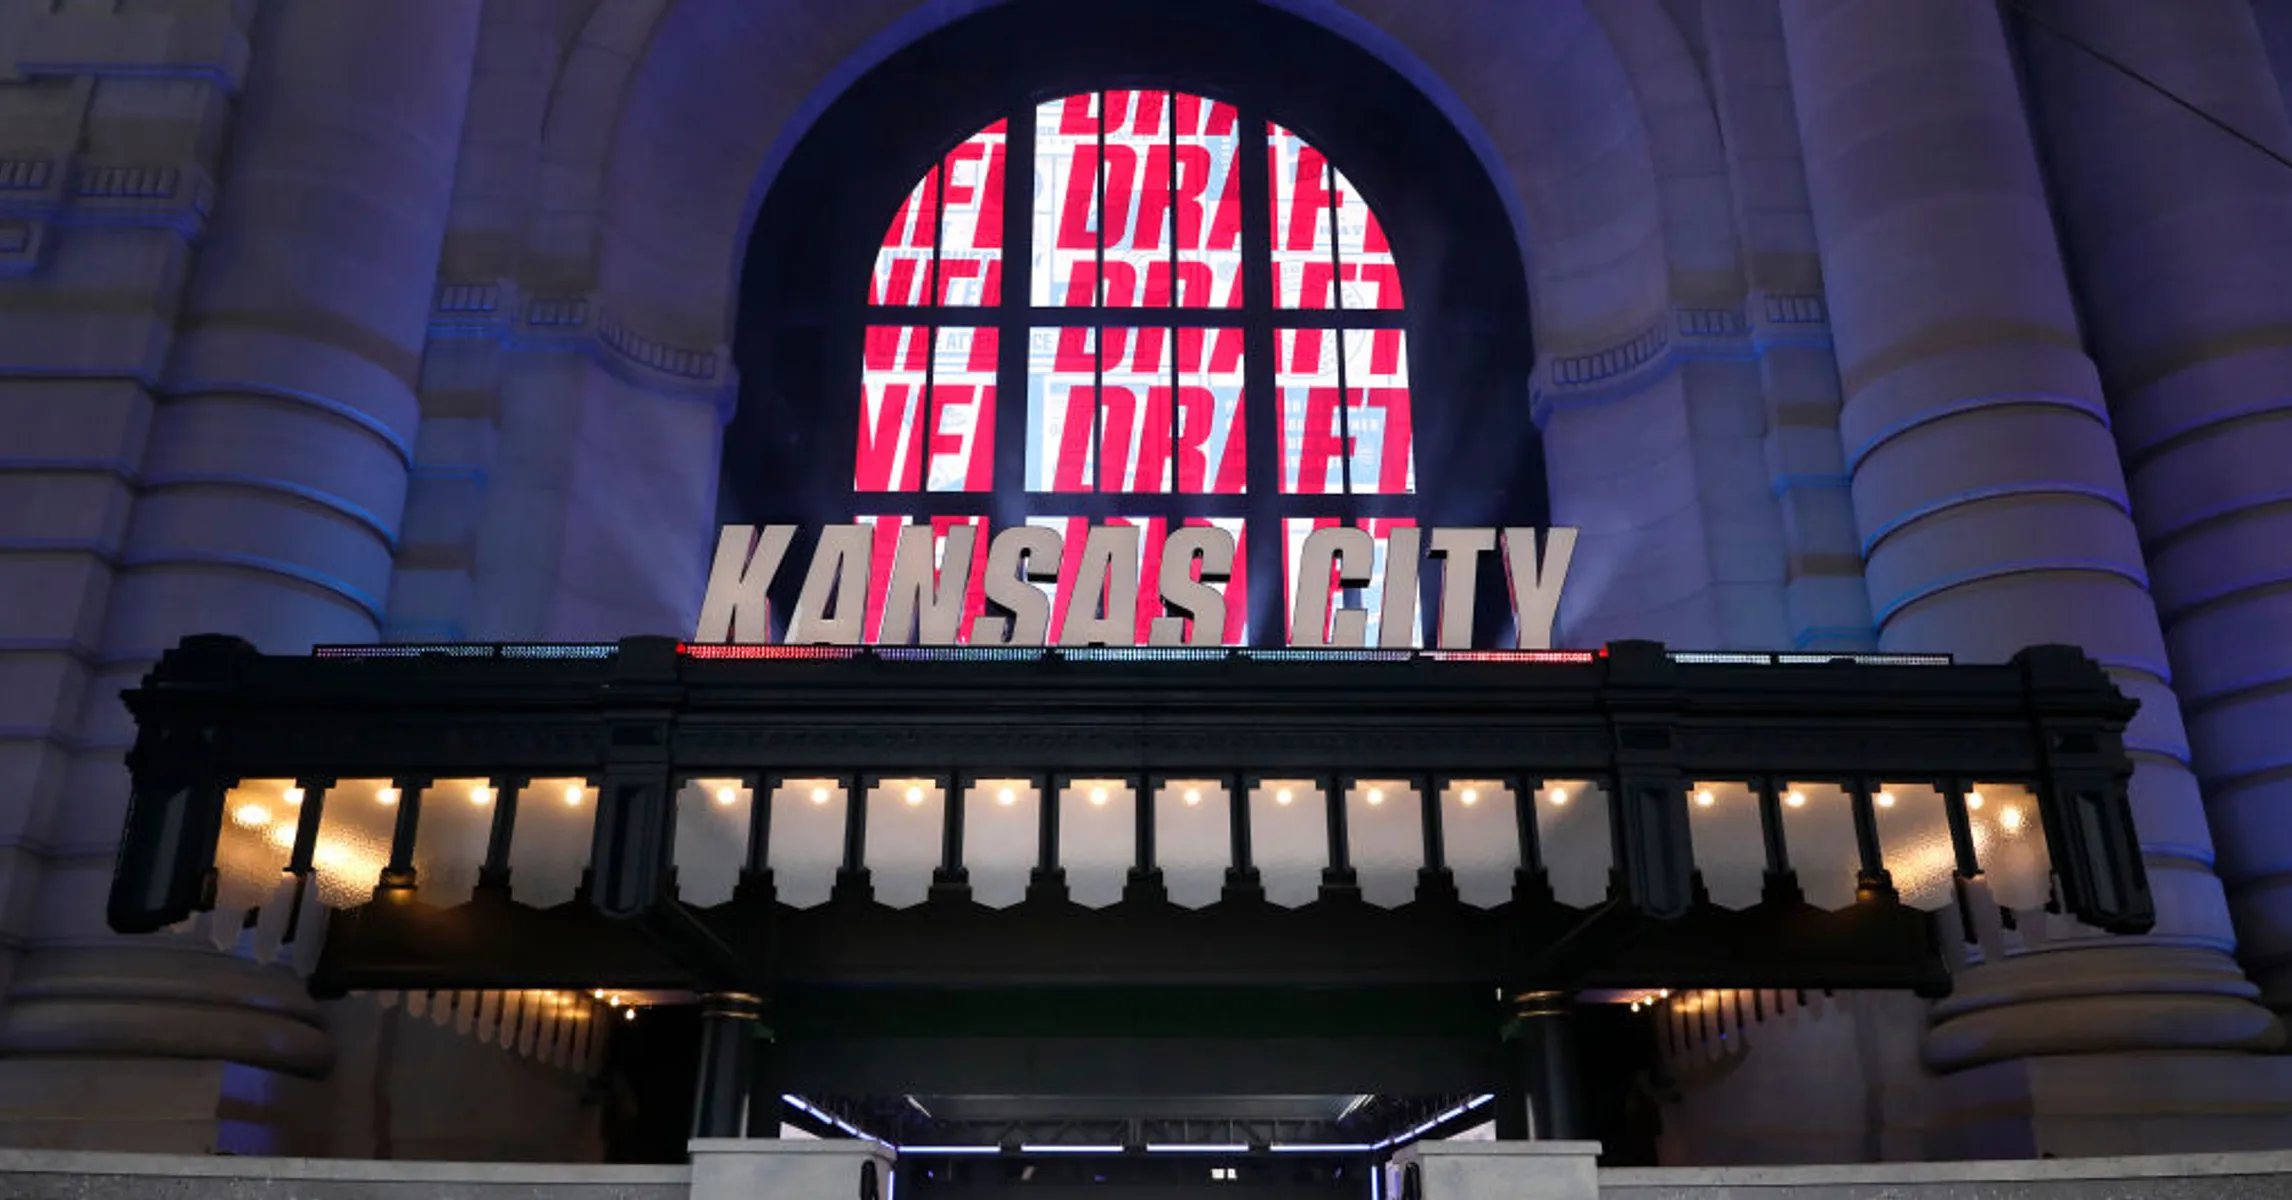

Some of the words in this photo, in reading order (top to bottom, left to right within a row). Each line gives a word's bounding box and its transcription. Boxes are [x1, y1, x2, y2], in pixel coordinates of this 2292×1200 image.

[1052, 385, 1414, 493] DRAFT
[695, 523, 1237, 648] KANSAS
[1290, 526, 1579, 649] CITY
